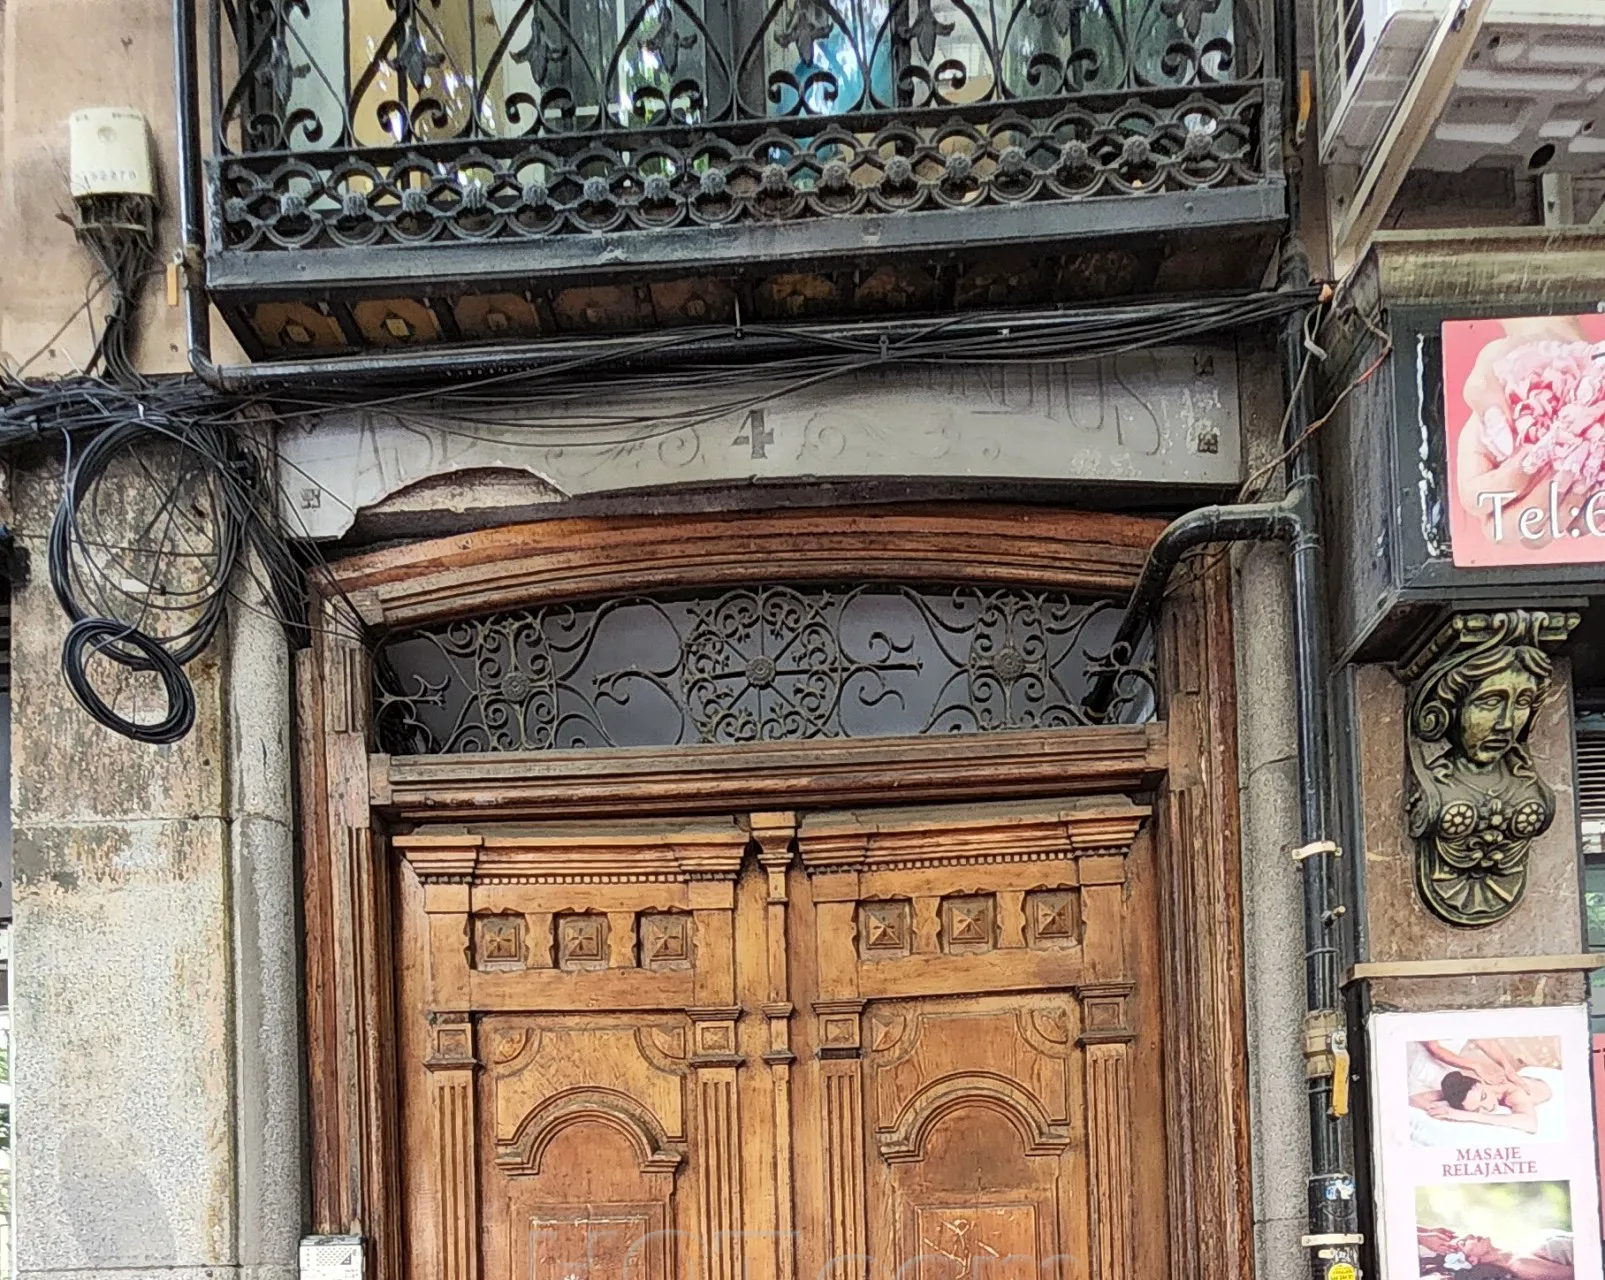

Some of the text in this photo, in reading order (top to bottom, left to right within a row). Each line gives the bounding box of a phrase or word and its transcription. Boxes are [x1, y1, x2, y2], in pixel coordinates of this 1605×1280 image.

[731, 408, 775, 460] 4
[1456, 1147, 1521, 1161] MASAJE
[1442, 1161, 1538, 1177] RELAJANTE
